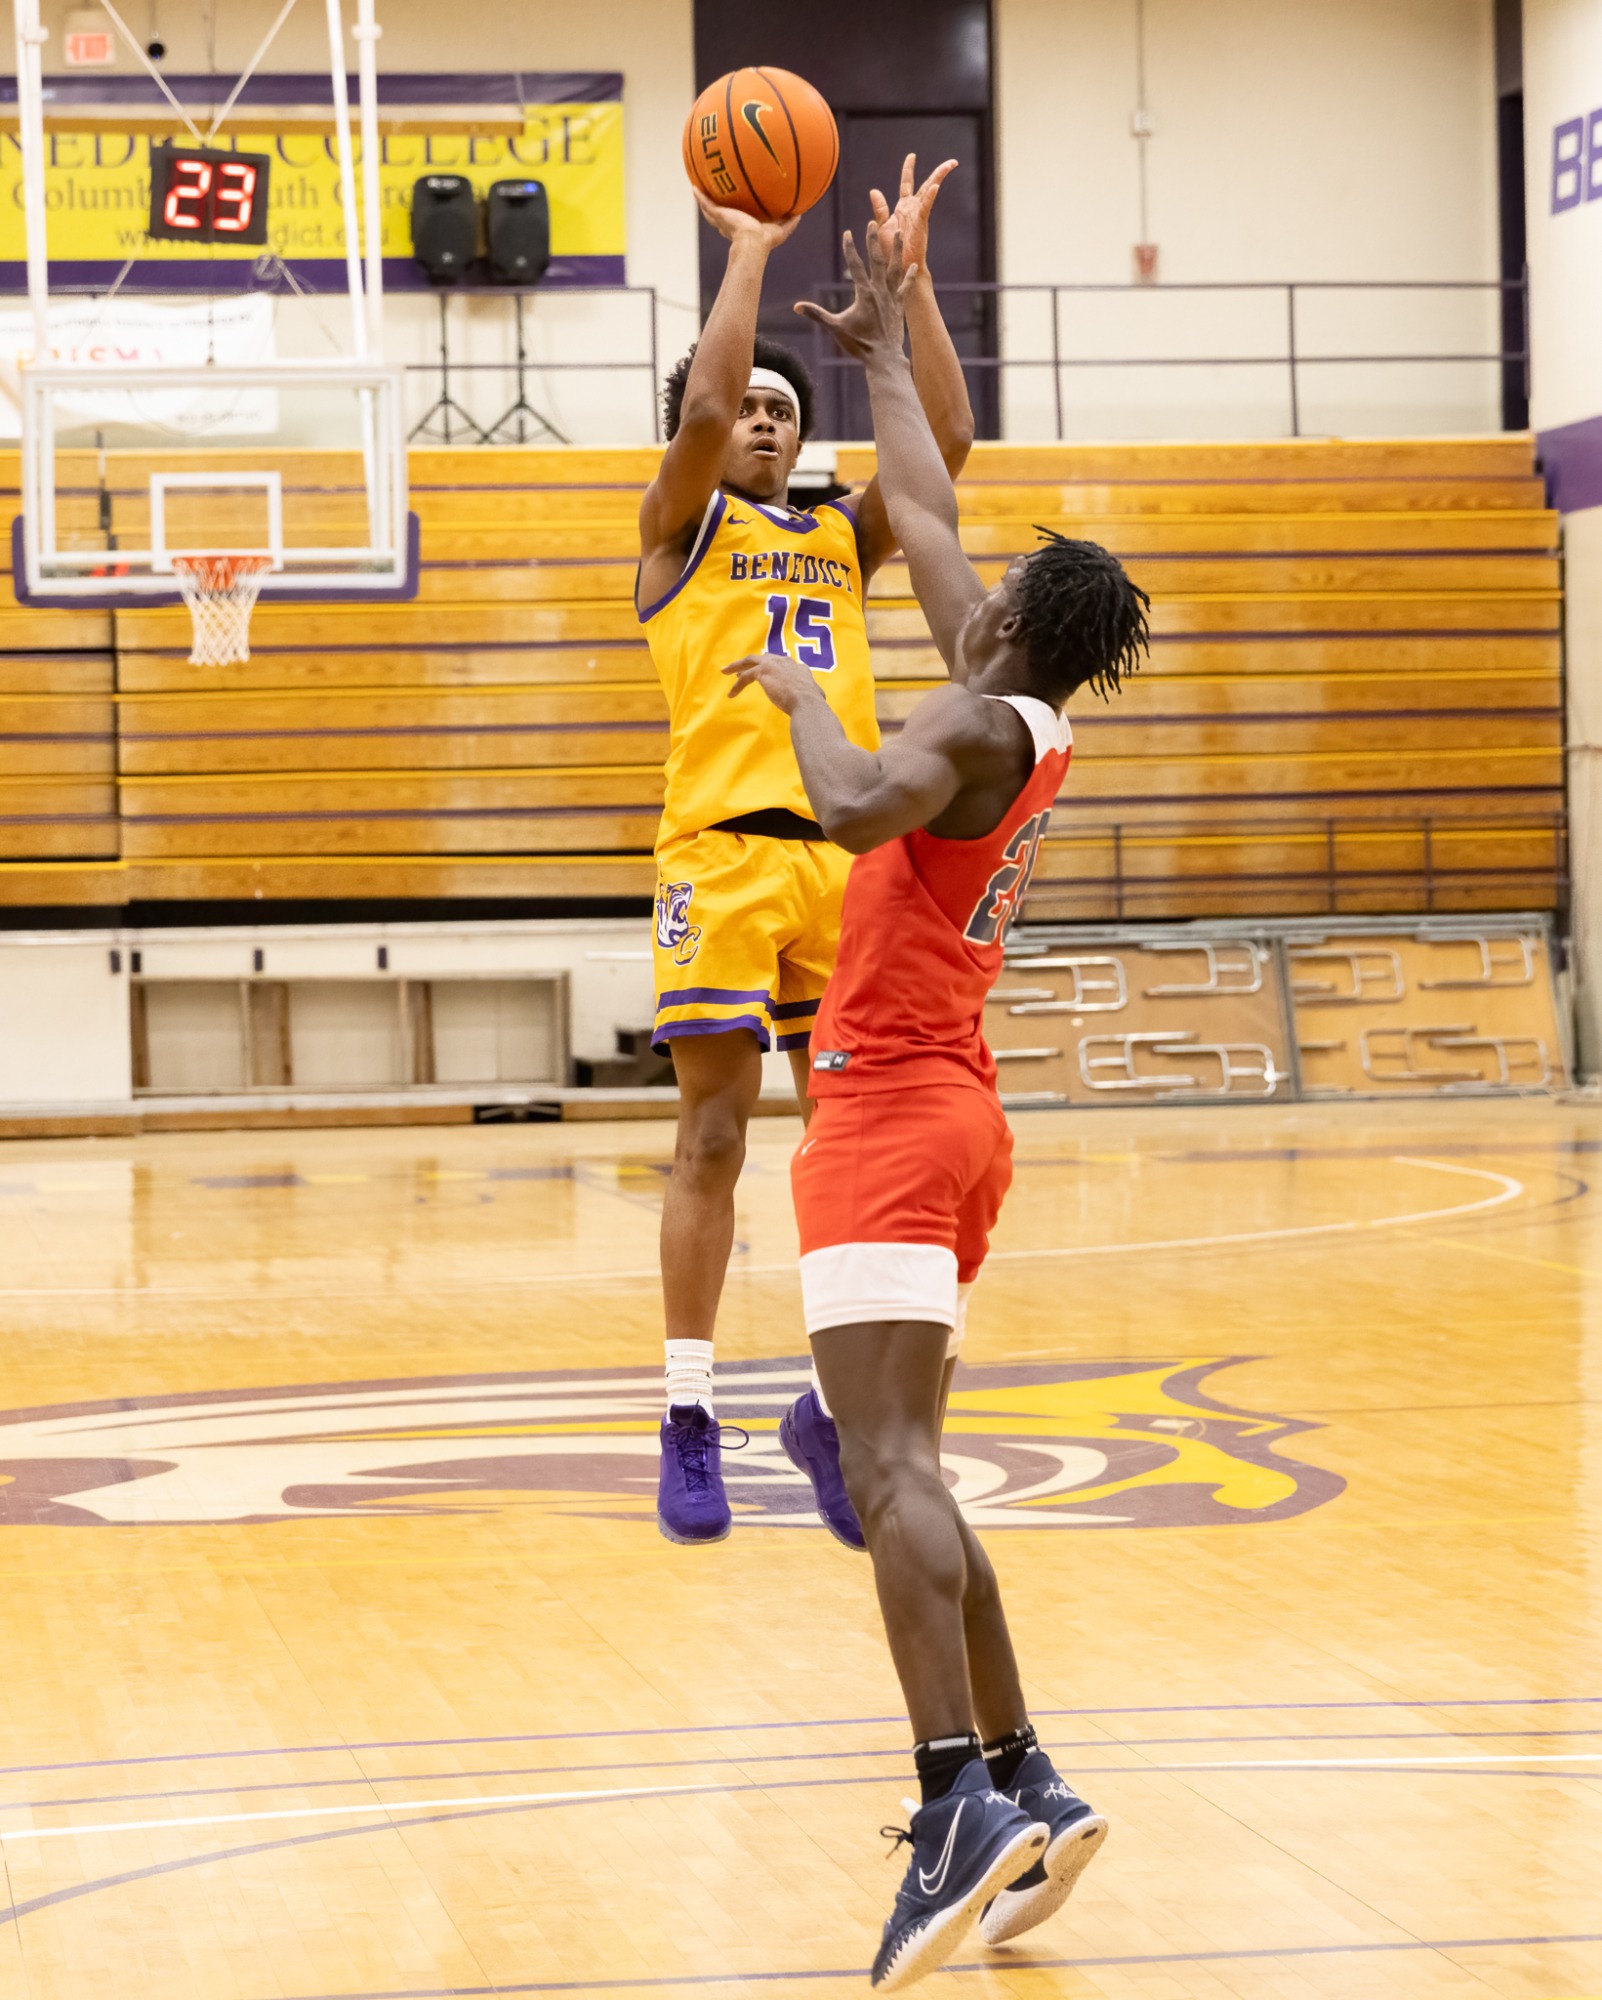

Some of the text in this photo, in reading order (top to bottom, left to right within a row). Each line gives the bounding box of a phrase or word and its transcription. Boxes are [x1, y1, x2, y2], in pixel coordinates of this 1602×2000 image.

[700, 112, 738, 196] ELITE
[163, 159, 257, 231] 23
[729, 550, 854, 593] BENEDICT
[762, 593, 838, 673] 15
